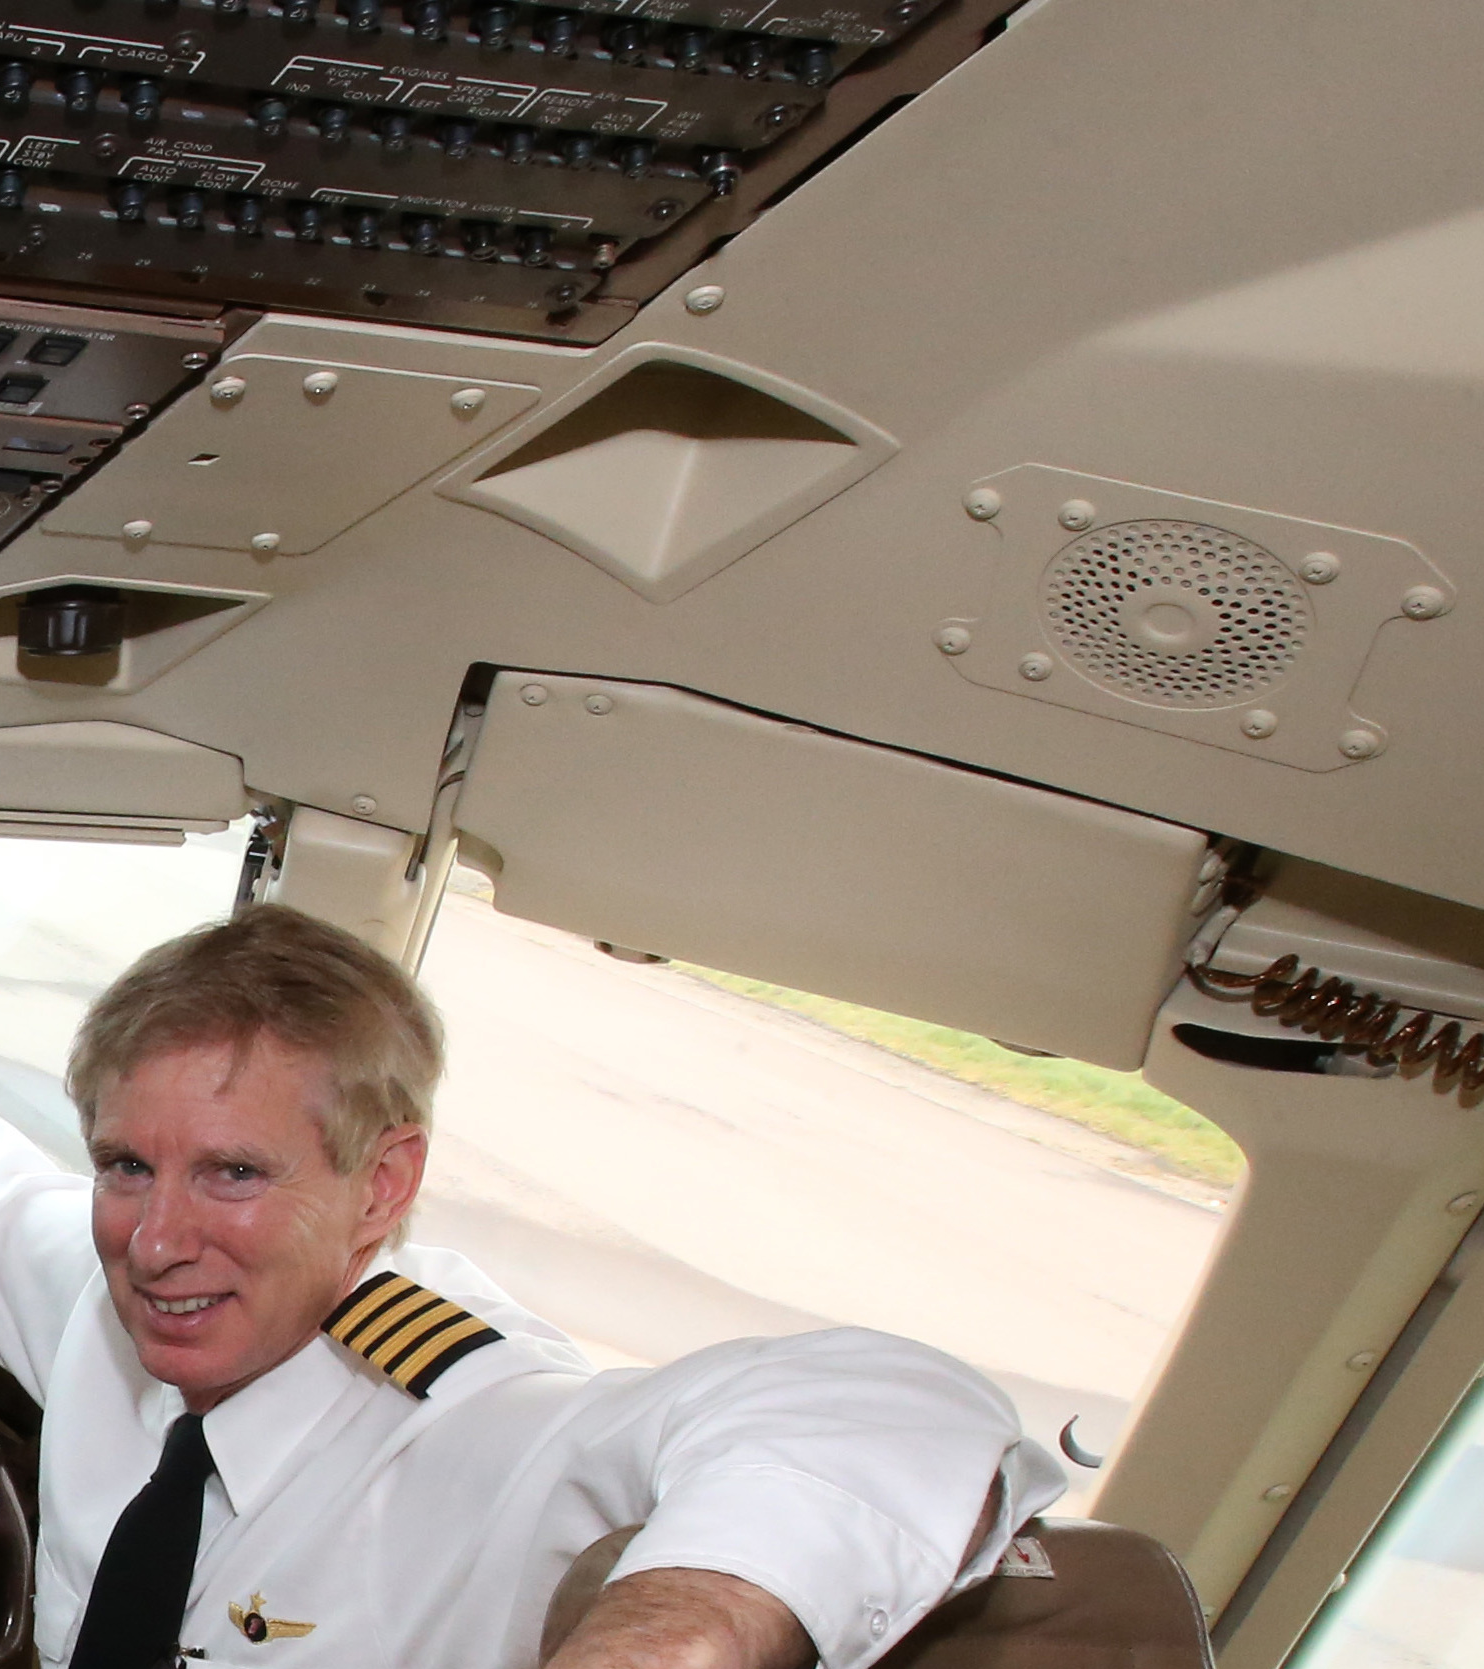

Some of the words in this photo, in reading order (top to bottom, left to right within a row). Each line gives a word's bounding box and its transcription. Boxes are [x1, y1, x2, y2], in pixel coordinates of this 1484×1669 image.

[117, 49, 169, 63] CARGO
[390, 66, 450, 81] ENGINES
[285, 83, 311, 93] IND
[453, 85, 494, 97] SPEED
[342, 90, 382, 102] CONT
[409, 99, 441, 110] LEFT
[541, 95, 592, 109] REMOTE
[468, 107, 510, 118] RIGHT
[592, 121, 631, 132] CONT
[27, 141, 59, 151] LEFT
[145, 137, 166, 147] AIR
[174, 141, 213, 152] COND
[22, 150, 55, 160] STBY
[147, 147, 183, 158] PACK
[13, 158, 52, 169] CONT
[176, 159, 217, 171] RIGHT
[139, 164, 177, 175] AUTO
[134, 172, 171, 183] CONT
[200, 171, 239, 183] FLOW
[194, 180, 233, 190] CONT
[260, 179, 300, 190] DOME
[55, 326, 116, 341] INDICATOR
